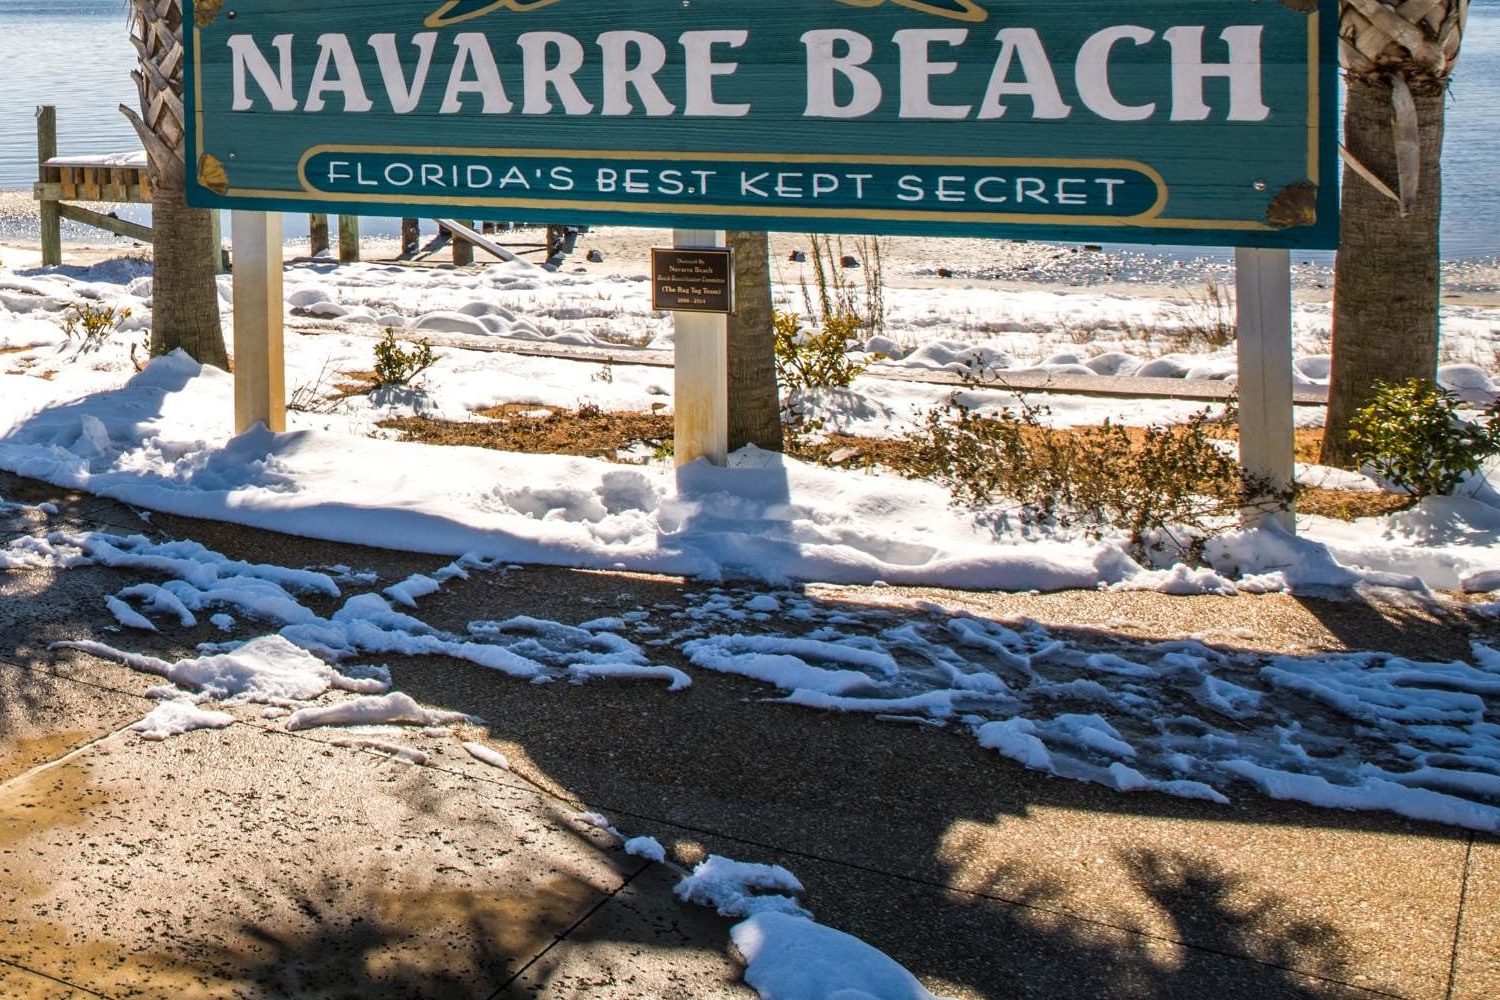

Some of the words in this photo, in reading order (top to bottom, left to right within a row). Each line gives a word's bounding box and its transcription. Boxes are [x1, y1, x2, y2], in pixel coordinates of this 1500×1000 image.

[226, 28, 752, 117] NAVARRE
[800, 24, 1271, 122] BEACH
[327, 160, 576, 192] FLORIDA'S
[596, 167, 717, 196] BEST
[740, 171, 873, 200] KEPT
[896, 174, 1126, 206] SECRET
[669, 265, 693, 273] Navarre
[677, 286, 690, 294] Rag
